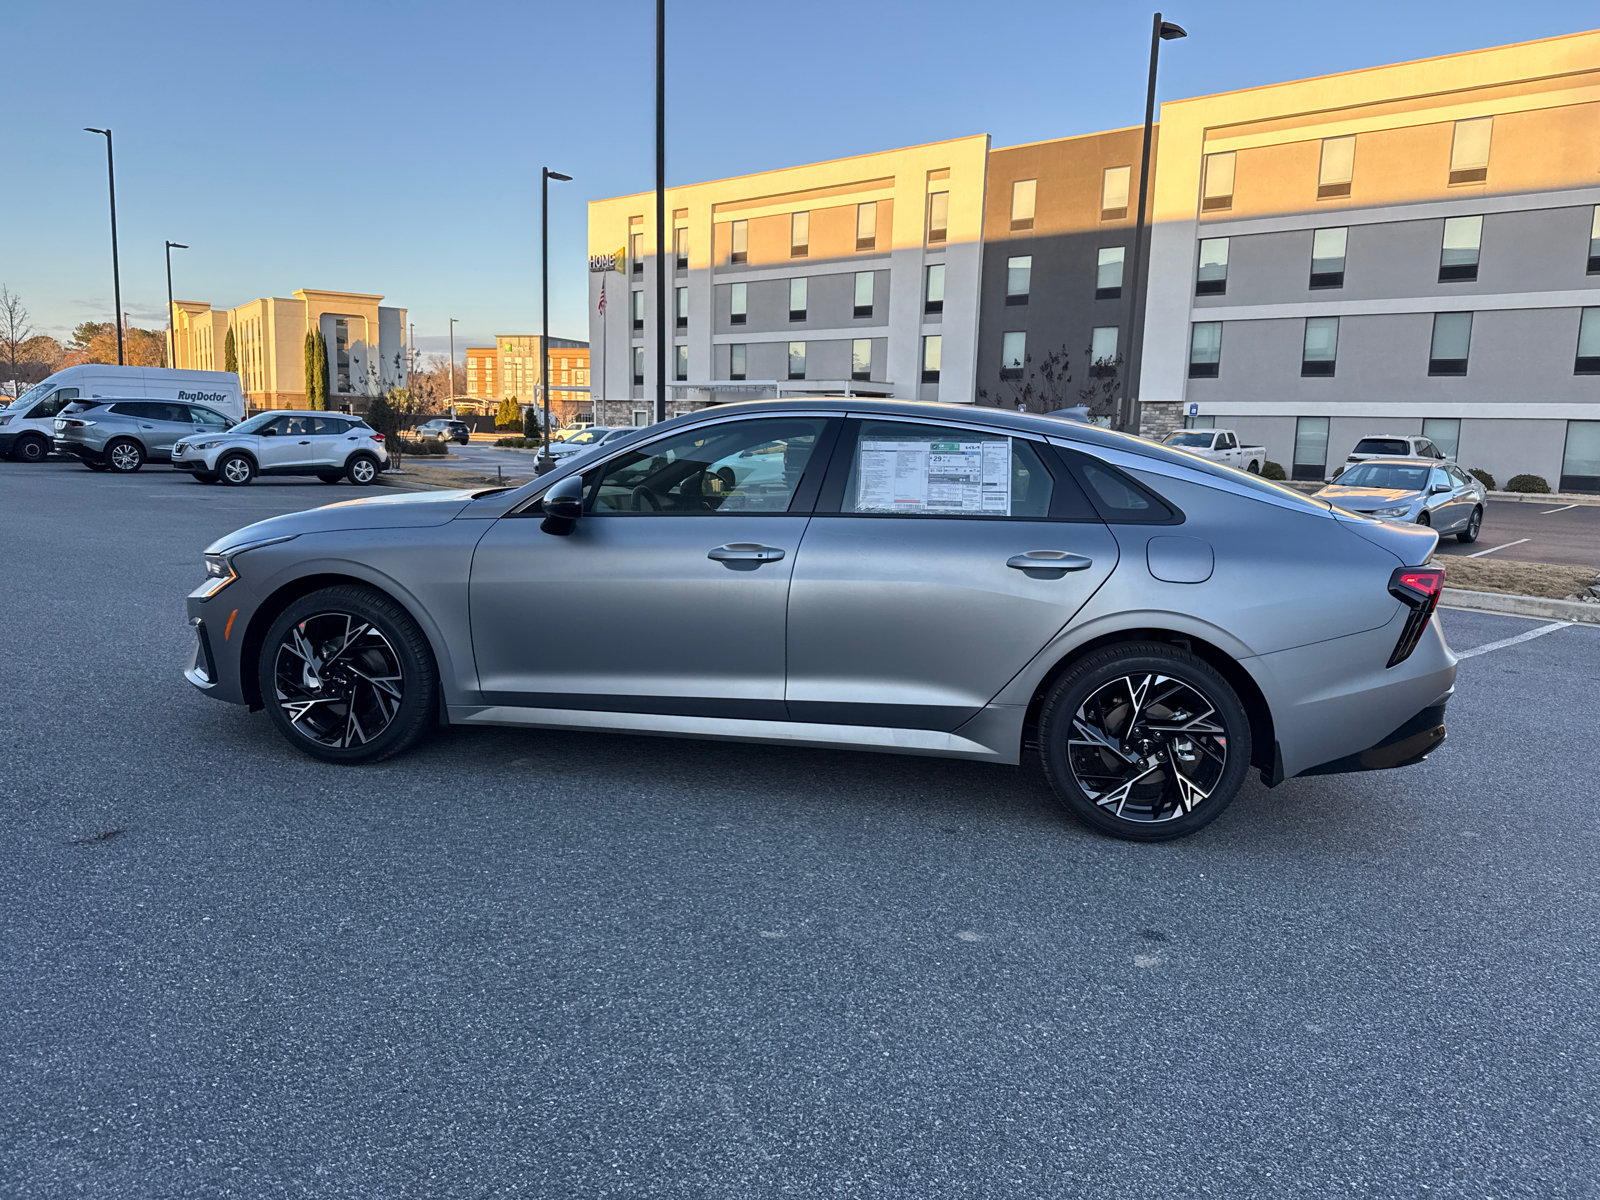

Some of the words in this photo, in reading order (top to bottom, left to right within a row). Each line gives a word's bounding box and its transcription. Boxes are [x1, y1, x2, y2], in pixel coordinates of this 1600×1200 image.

[589, 253, 615, 269] HOME
[615, 250, 623, 271] 2
[178, 390, 226, 402] RugDoctor
